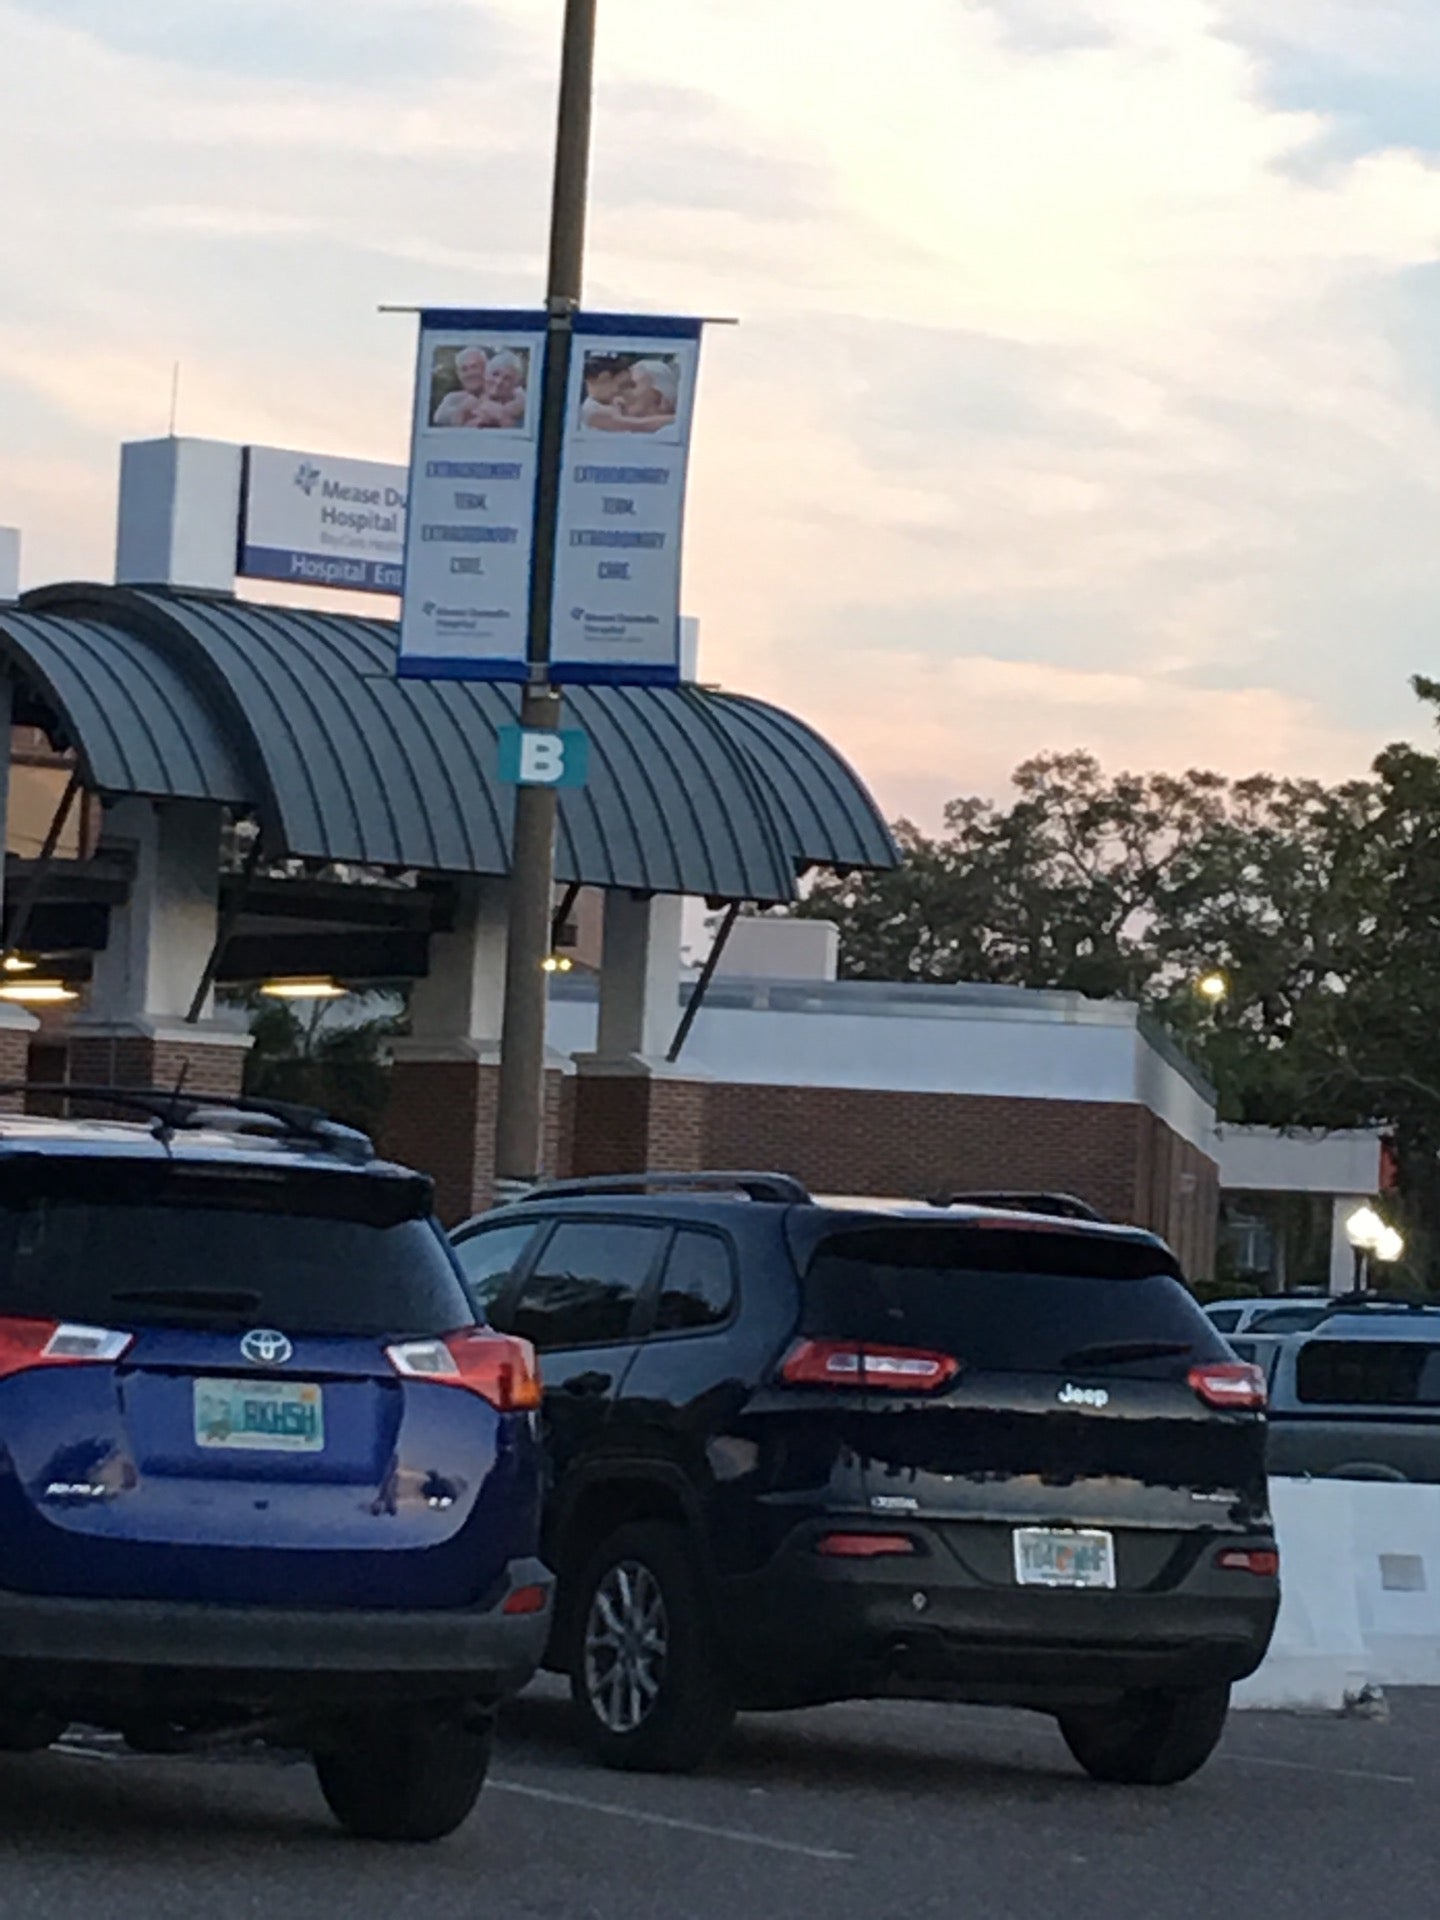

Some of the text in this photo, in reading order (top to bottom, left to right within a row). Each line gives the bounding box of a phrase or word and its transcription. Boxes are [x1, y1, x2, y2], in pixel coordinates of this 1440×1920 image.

[322, 479, 381, 505] Mease
[321, 505, 398, 533] Hospital
[290, 554, 367, 583] Hospital
[520, 732, 565, 782] B
[1058, 1383, 1109, 1408] Jeep
